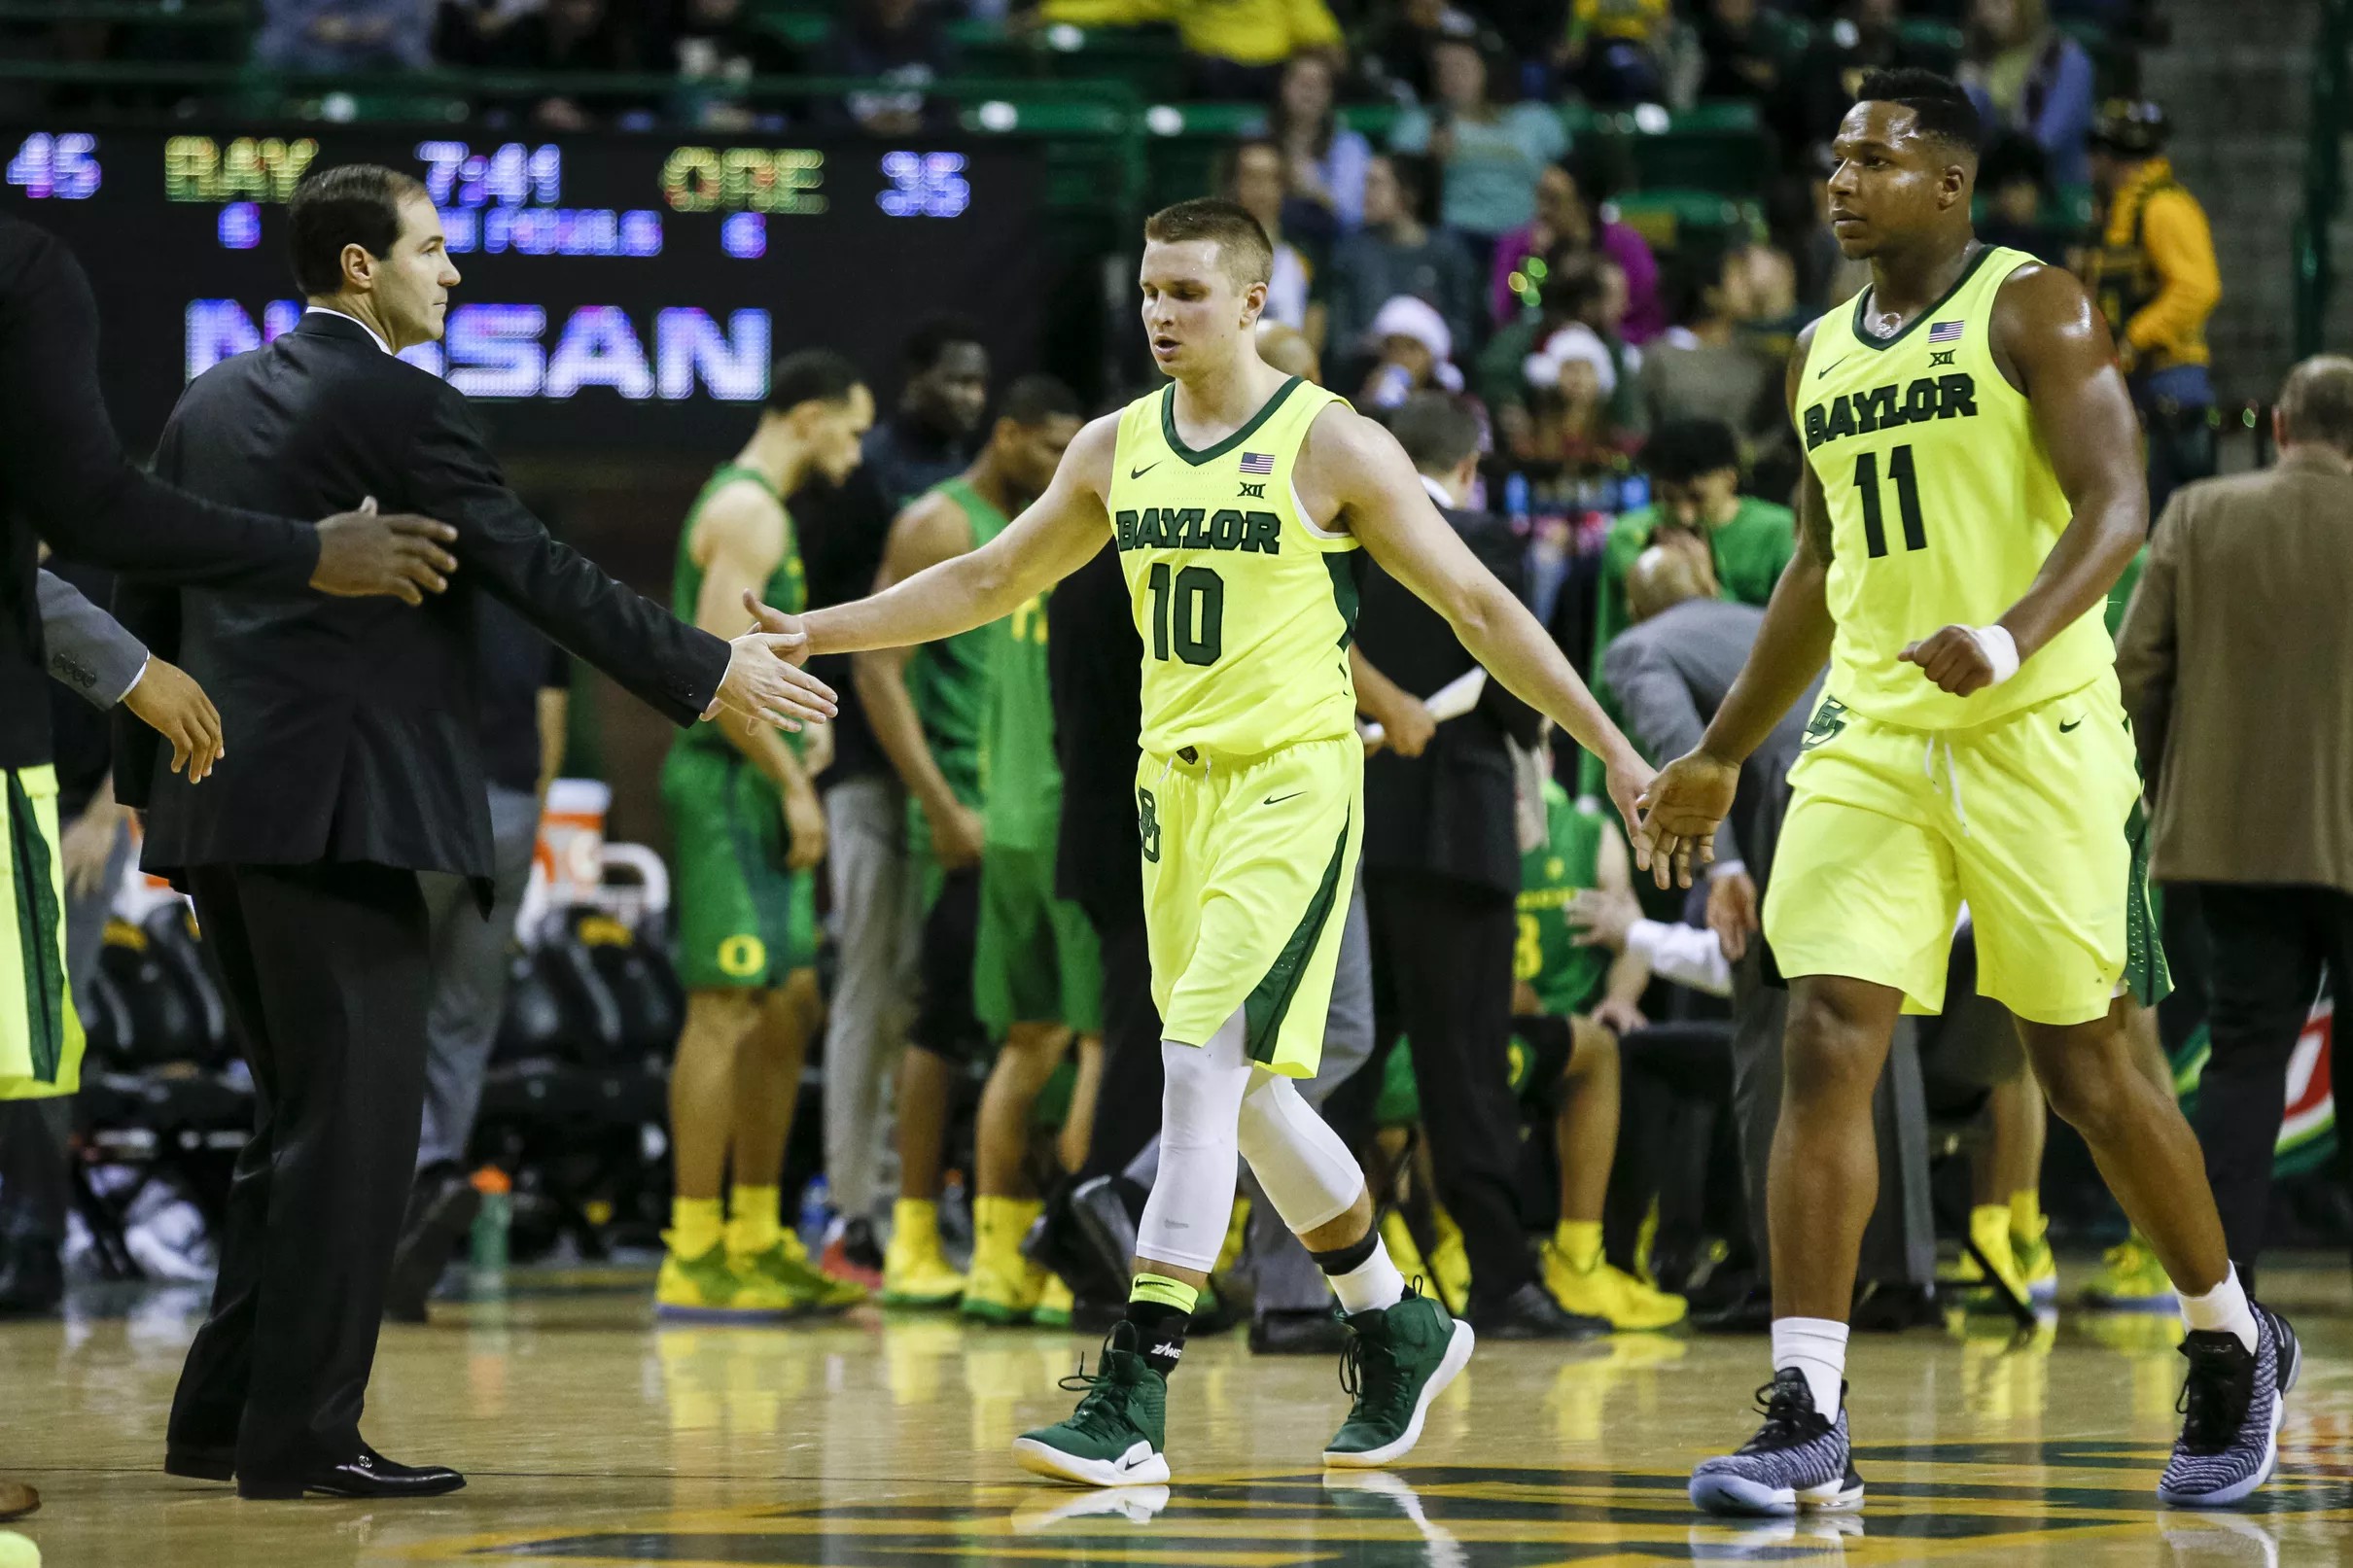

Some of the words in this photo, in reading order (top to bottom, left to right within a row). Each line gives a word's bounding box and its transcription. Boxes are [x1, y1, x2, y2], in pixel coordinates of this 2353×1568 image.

[7, 132, 101, 198] 45
[414, 141, 560, 208] 7:41
[658, 146, 828, 214] ORE
[876, 151, 969, 217] 35
[1804, 372, 1979, 453] BAYLOR
[1115, 507, 1282, 555] BAYLOR
[1852, 444, 1928, 559] 11
[1148, 562, 1224, 667] 10
